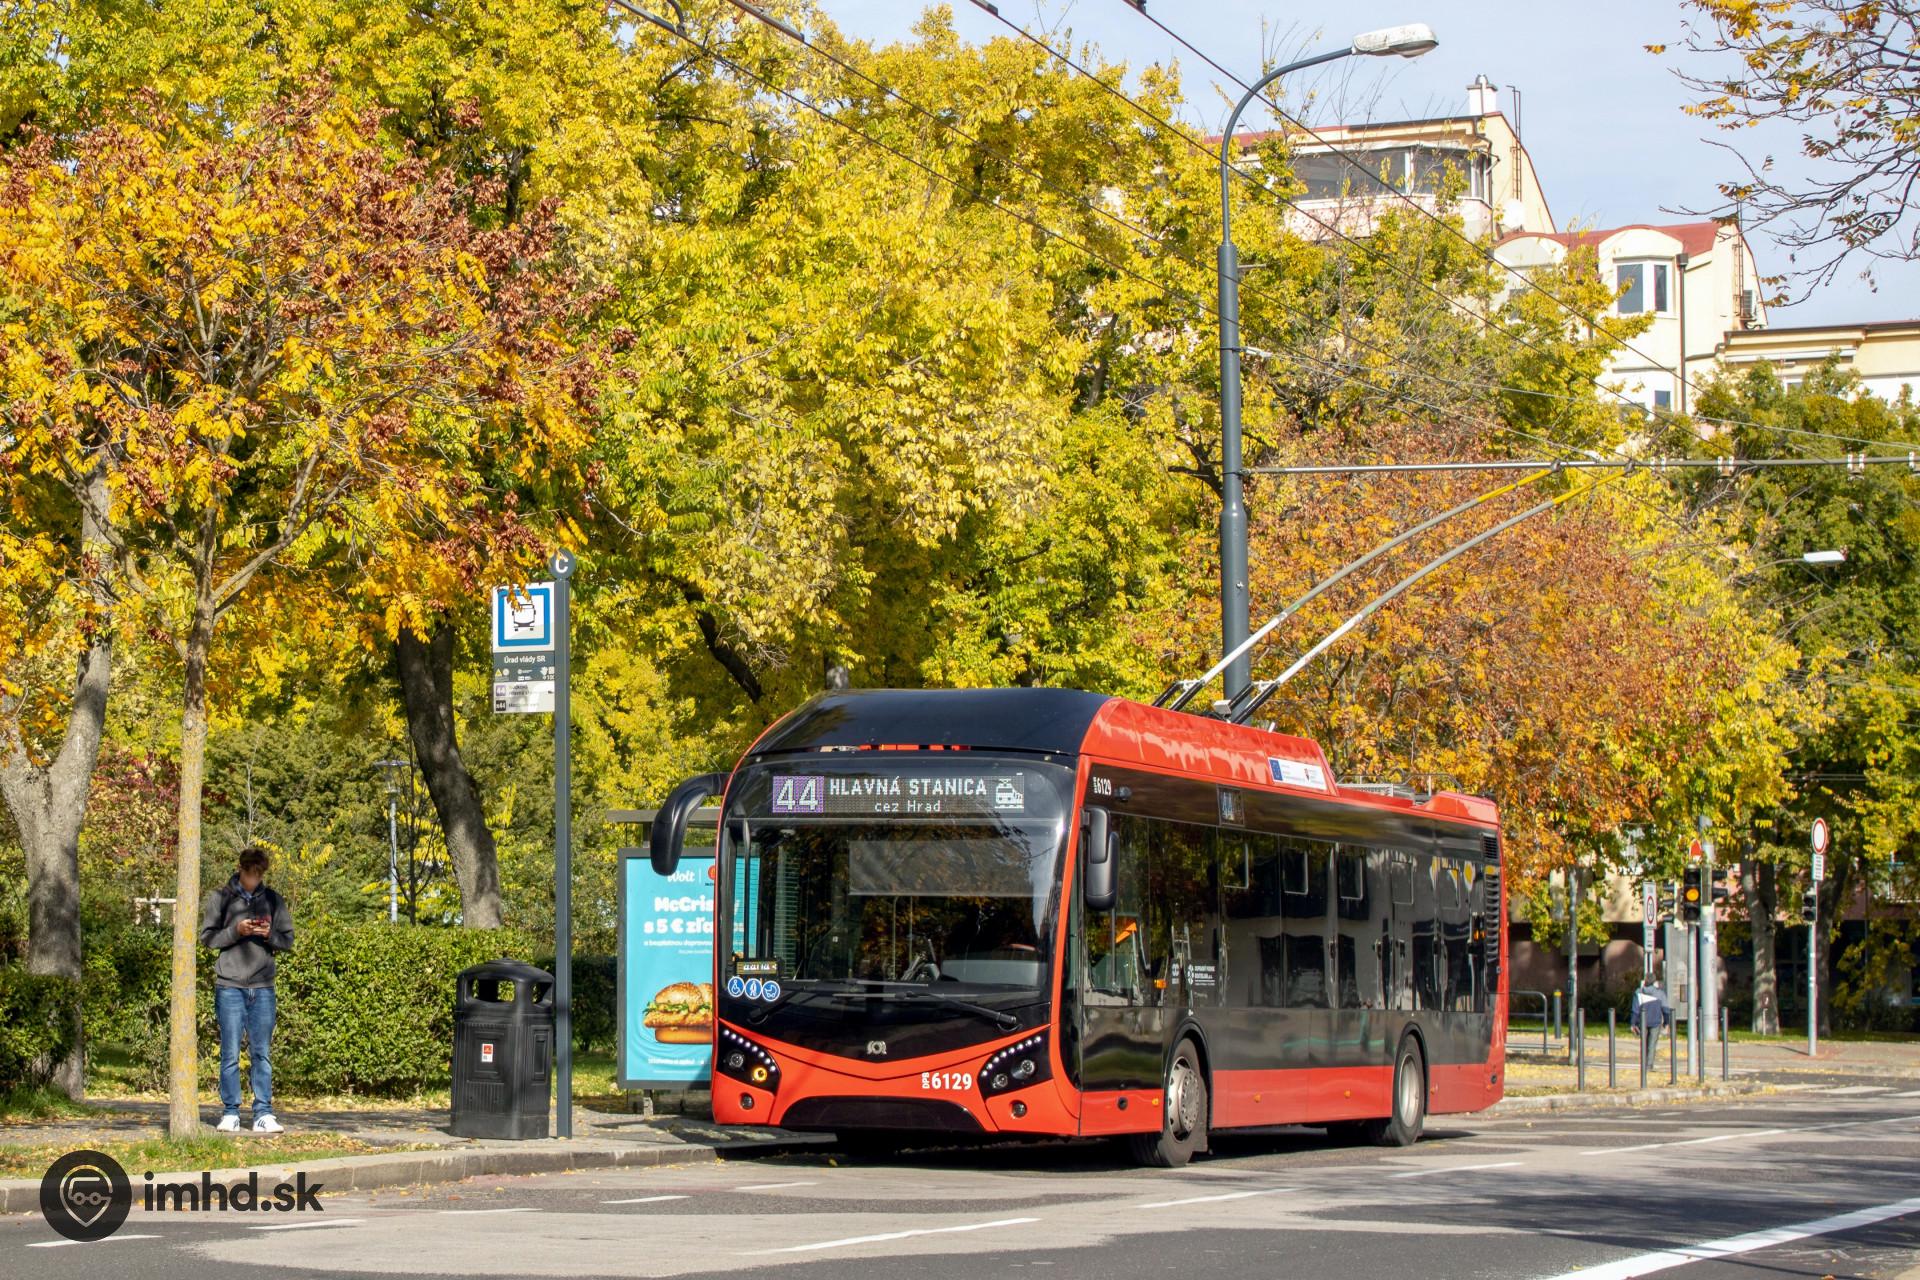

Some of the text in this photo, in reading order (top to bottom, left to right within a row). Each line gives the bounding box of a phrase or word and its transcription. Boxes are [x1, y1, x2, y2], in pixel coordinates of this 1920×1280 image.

[504, 655, 518, 663] Úrad
[777, 776, 987, 810] 44 HLAVNÁ STANICA
[1097, 777, 1112, 796] 6129
[874, 799, 941, 813] cez Hrad
[654, 895, 715, 912] McCris
[656, 918, 668, 934] 5
[671, 918, 684, 934] €
[686, 916, 714, 933] zľa
[921, 1072, 972, 1090] DPB 6129
